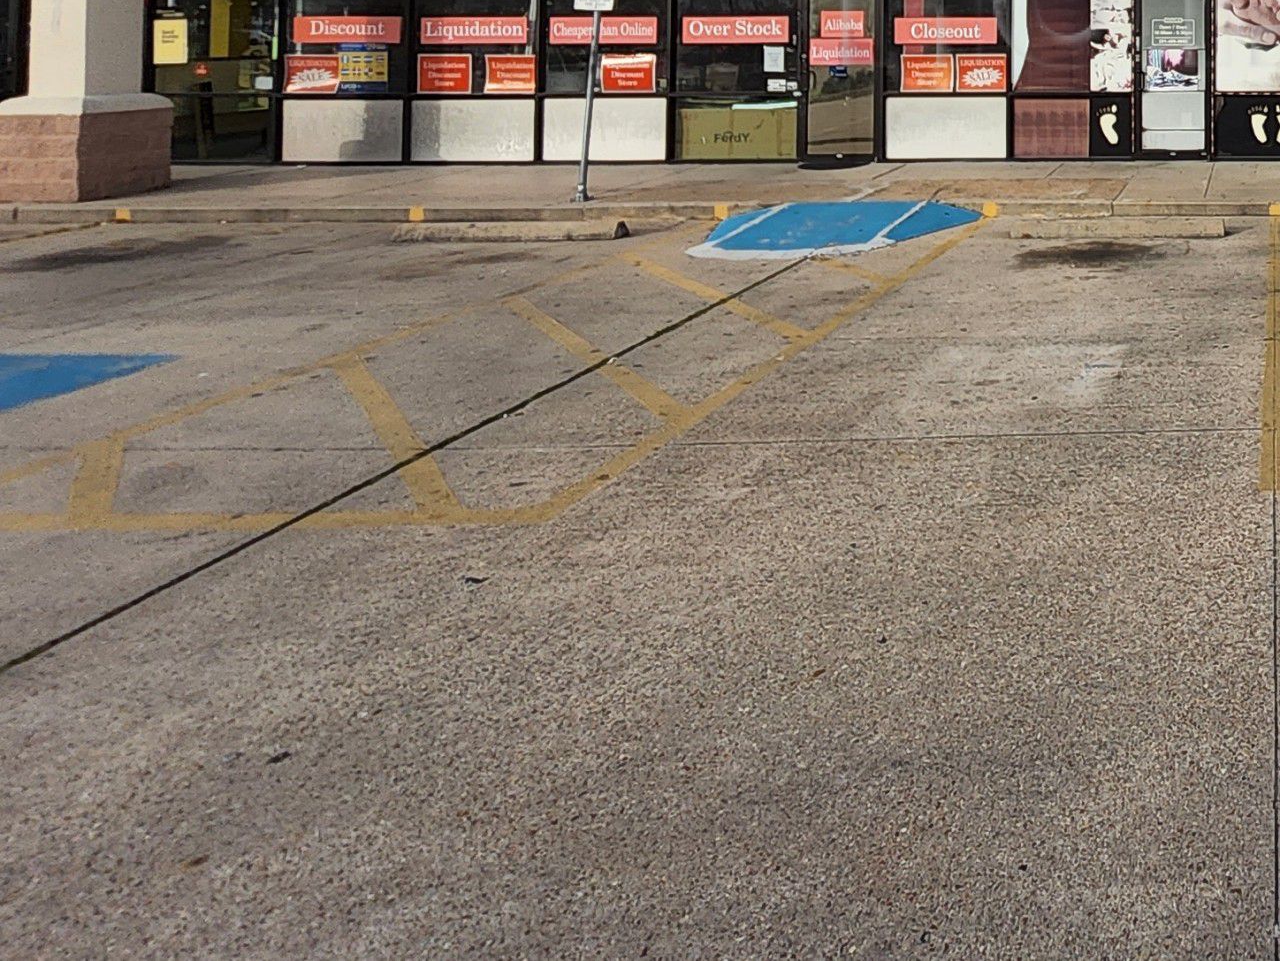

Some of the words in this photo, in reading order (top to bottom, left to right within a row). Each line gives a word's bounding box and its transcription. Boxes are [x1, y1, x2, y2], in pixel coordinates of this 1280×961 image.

[309, 20, 385, 36] Discount
[425, 21, 524, 39] Liquidation
[553, 22, 594, 39] Cheaper
[600, 21, 618, 36] han
[620, 22, 653, 36] Online
[688, 20, 731, 36] Over
[734, 20, 782, 36] Stock
[825, 19, 864, 31] Alibaba
[910, 23, 981, 39] Closeout
[811, 46, 870, 61] Liquidation
[298, 72, 326, 82] SALE
[969, 70, 994, 81] SALE
